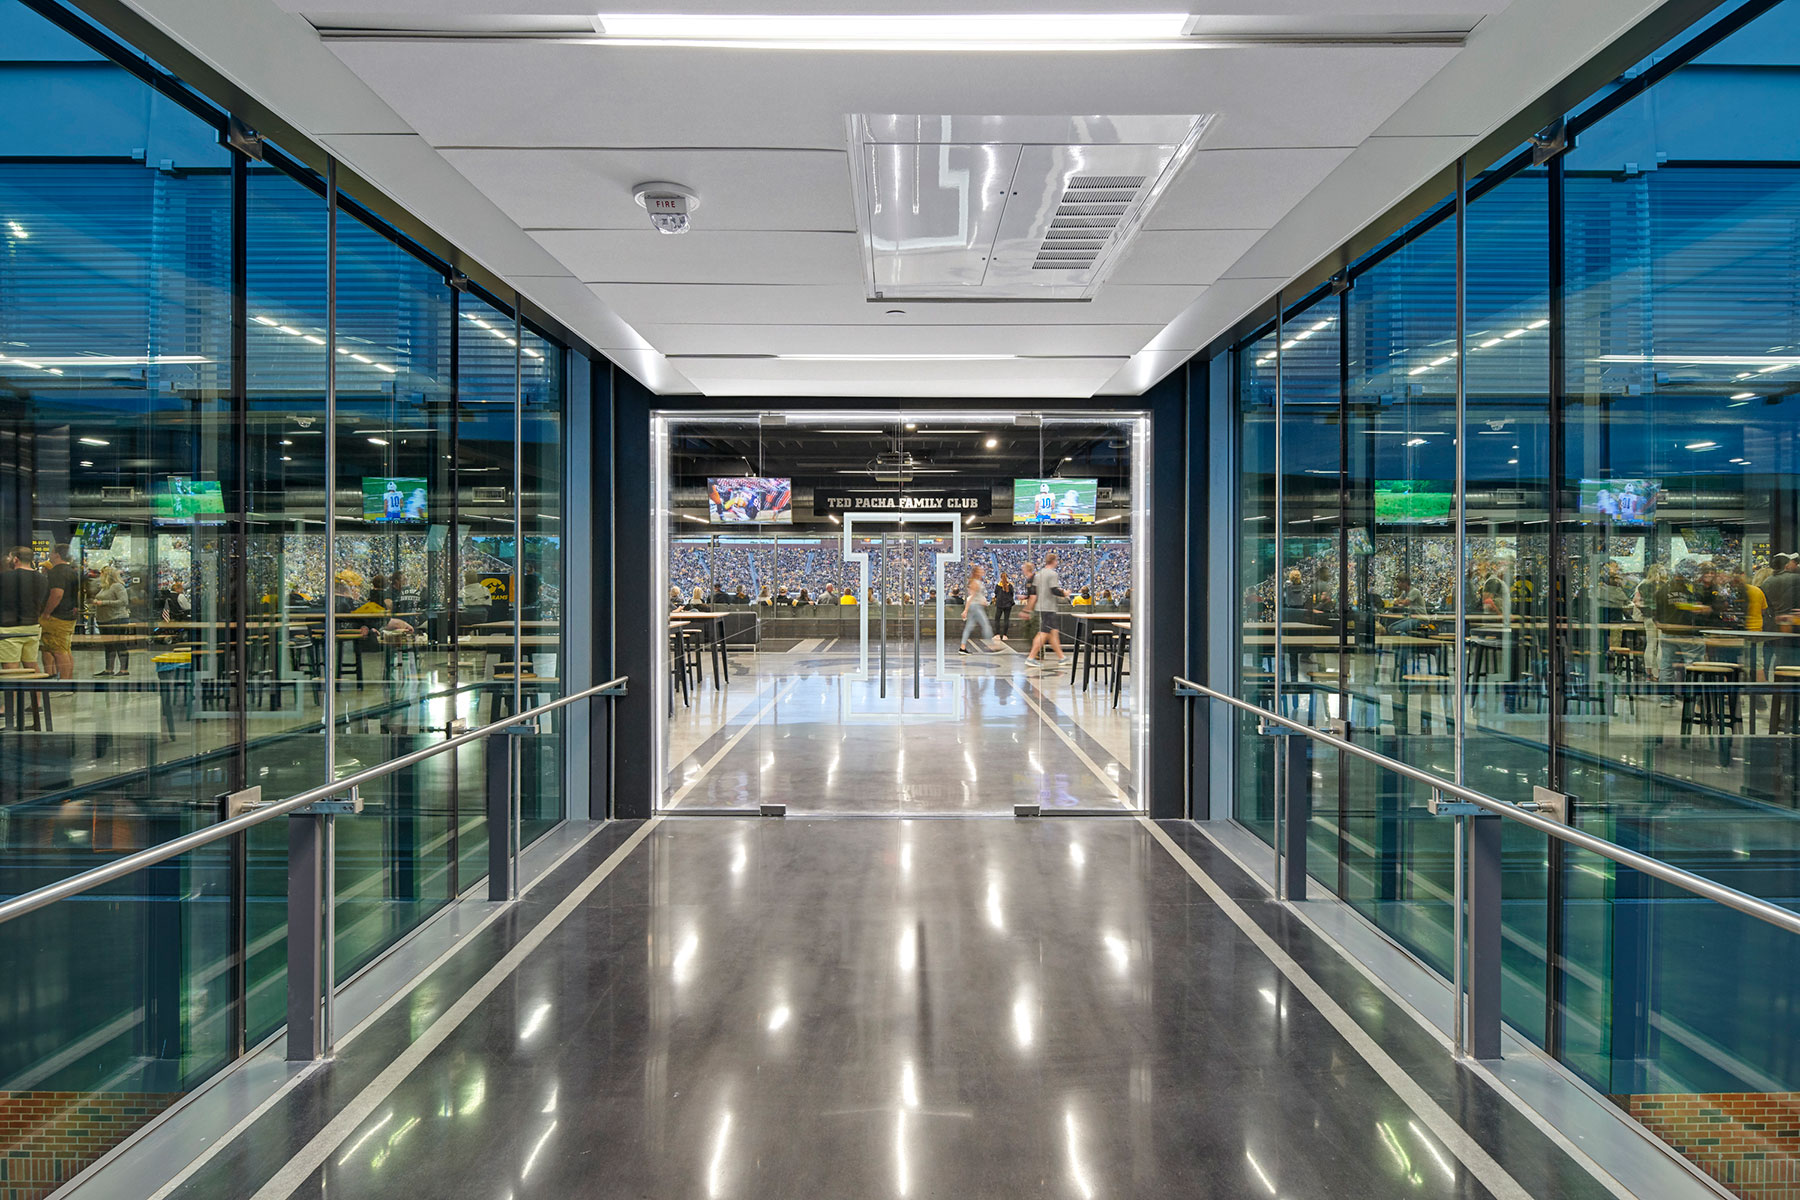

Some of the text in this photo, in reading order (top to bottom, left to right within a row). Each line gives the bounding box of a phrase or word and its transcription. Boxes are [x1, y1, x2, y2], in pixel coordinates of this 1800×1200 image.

[390, 495, 400, 508] 10
[827, 498, 979, 508] TED PACHA FAMILY CLUB
[1042, 498, 1051, 509] 10
